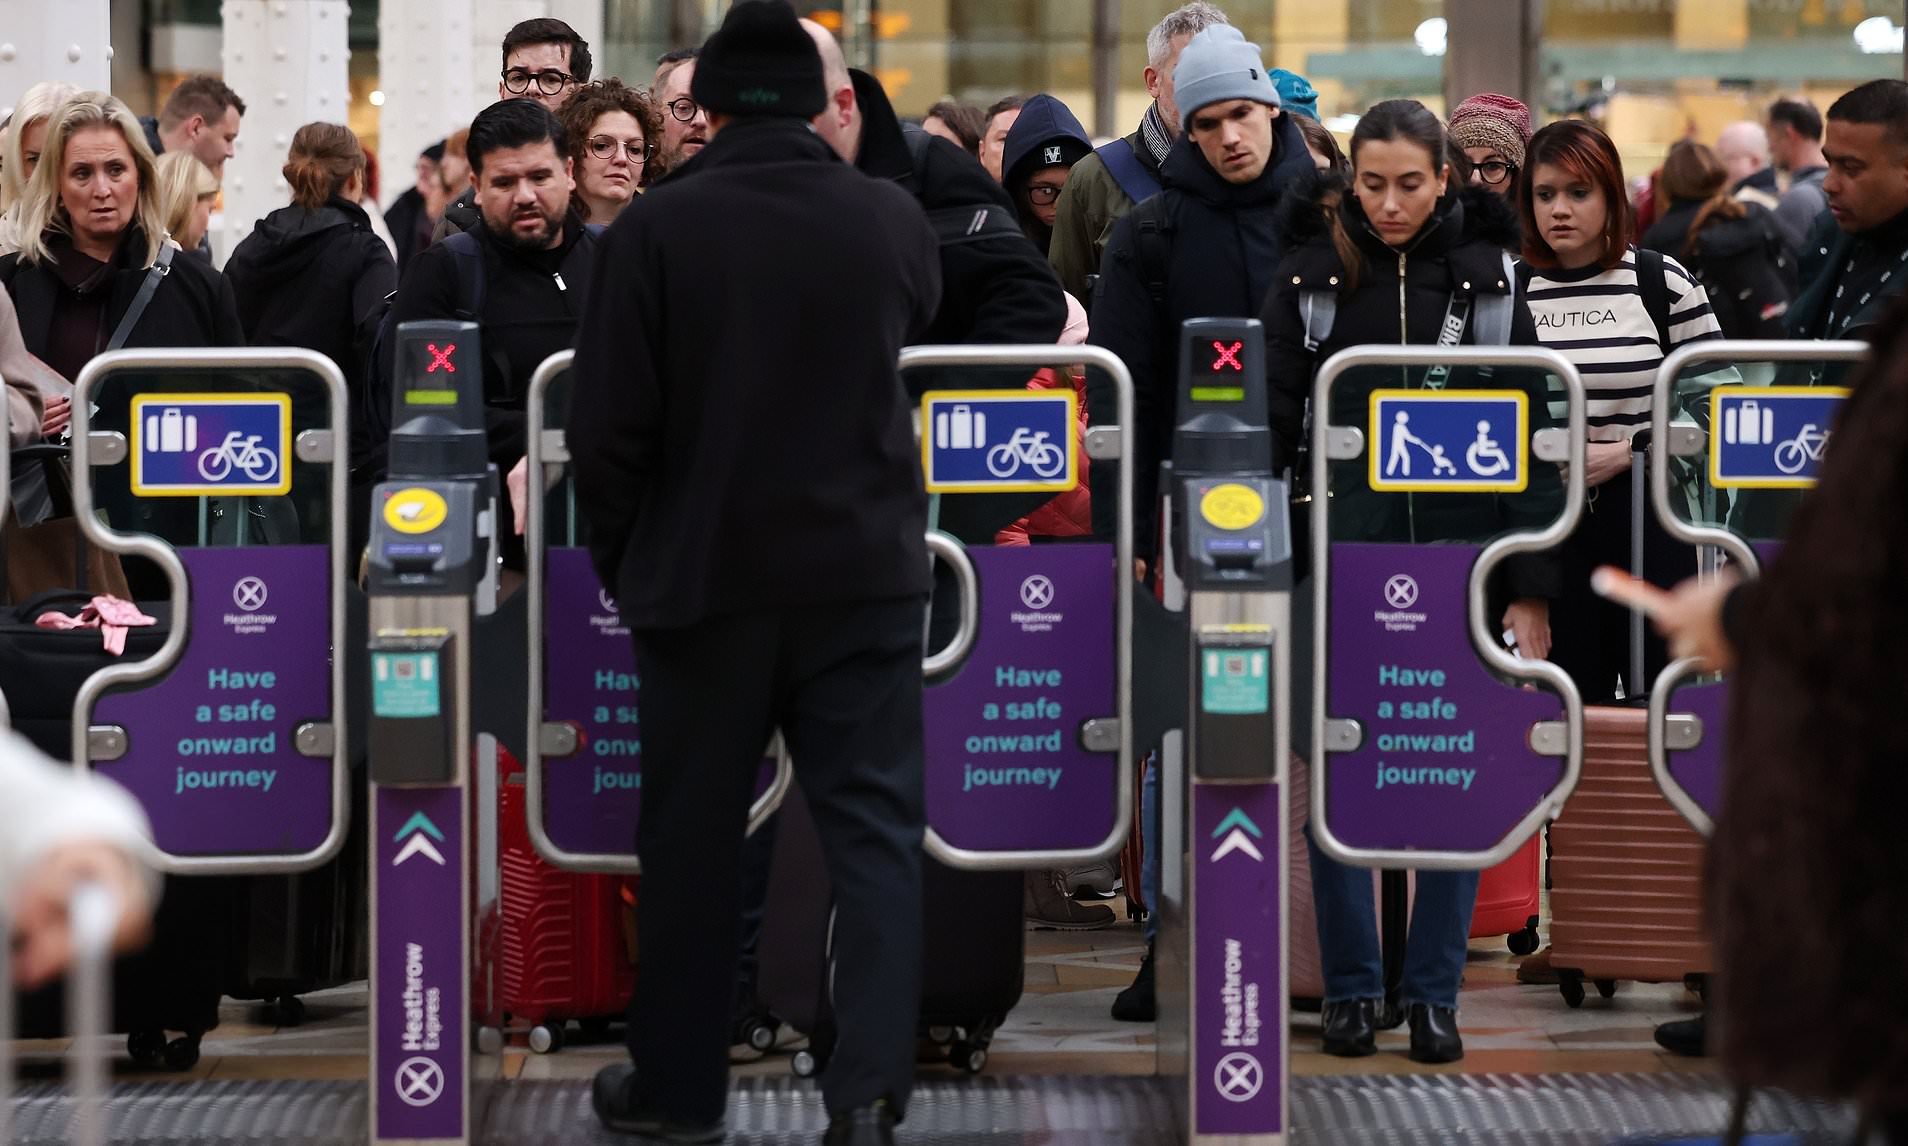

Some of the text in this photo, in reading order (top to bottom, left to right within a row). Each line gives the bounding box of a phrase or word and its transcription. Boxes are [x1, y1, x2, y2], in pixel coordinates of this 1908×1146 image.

[208, 668, 276, 690] Have
[595, 670, 641, 690] Hav
[995, 666, 1062, 687] Have
[1379, 665, 1446, 686] Have
[195, 699, 276, 722] a safe
[594, 706, 609, 723] a
[983, 697, 1062, 720] a safe
[1377, 696, 1457, 719] a safe
[177, 732, 275, 755] onward
[594, 738, 641, 756] onw
[965, 729, 1061, 753] onward
[1377, 730, 1474, 752] onward
[175, 767, 277, 794] journey
[593, 765, 641, 795] jour
[962, 763, 1062, 791] journey
[1375, 761, 1475, 790] journey
[401, 942, 423, 1051] Heathrow
[1221, 938, 1242, 1046] Heathrow
[423, 986, 444, 1051] Express
[1242, 982, 1262, 1046] Express
